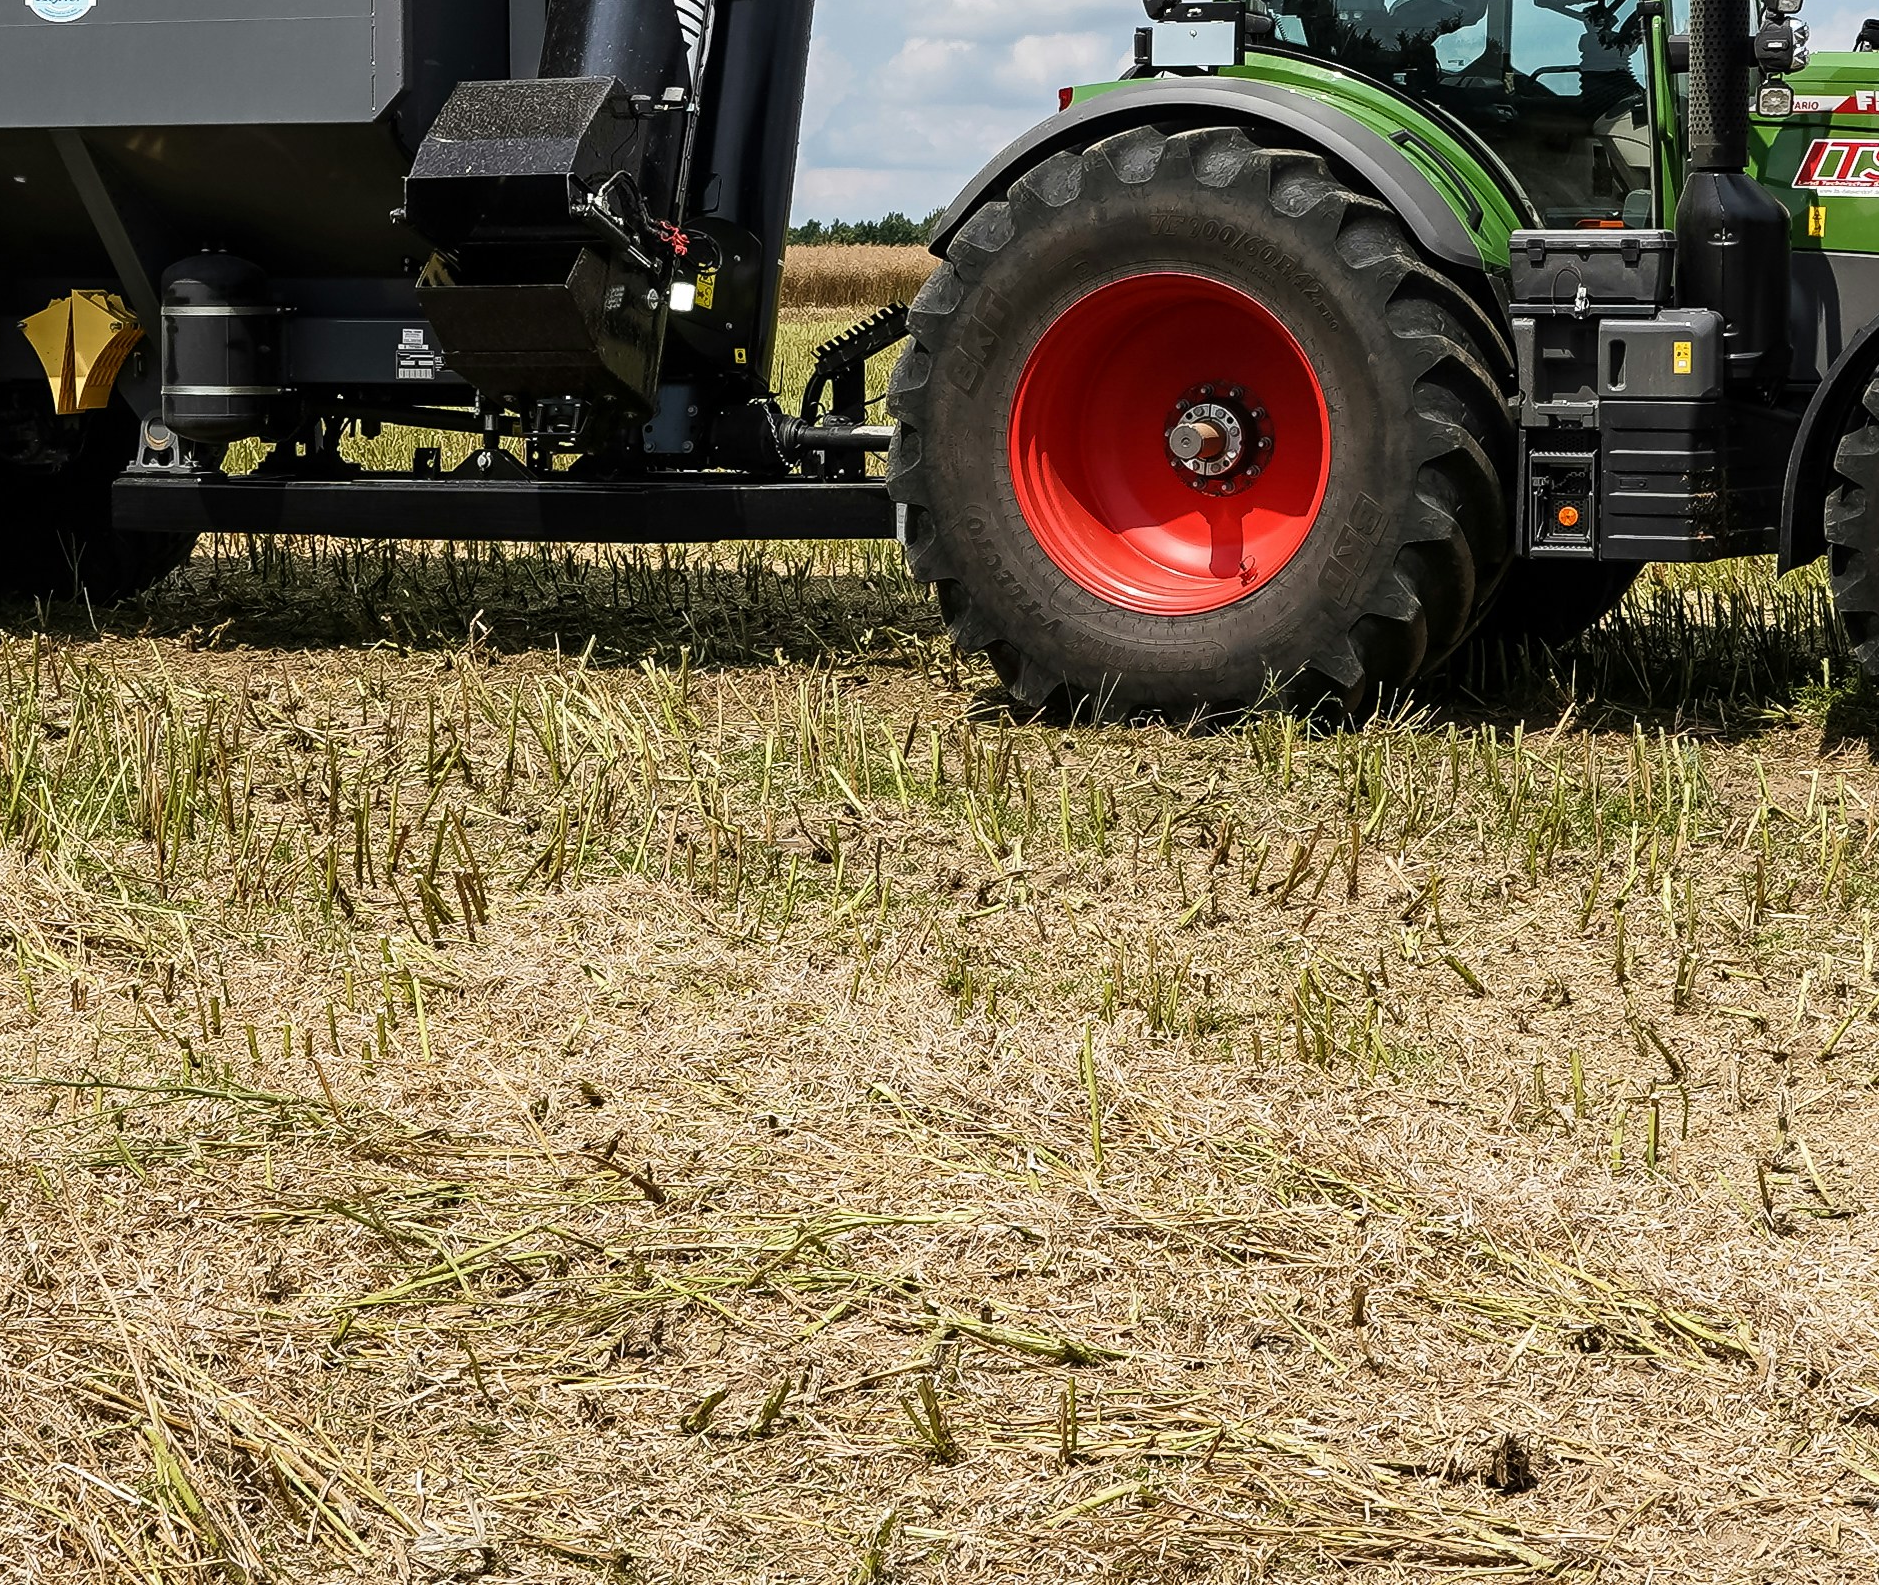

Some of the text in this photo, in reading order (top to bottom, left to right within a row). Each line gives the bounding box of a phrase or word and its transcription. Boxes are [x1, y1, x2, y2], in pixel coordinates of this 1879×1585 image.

[1792, 101, 1820, 111] ARIO
[946, 287, 1010, 396] BKT
[1319, 493, 1388, 607] BKT
